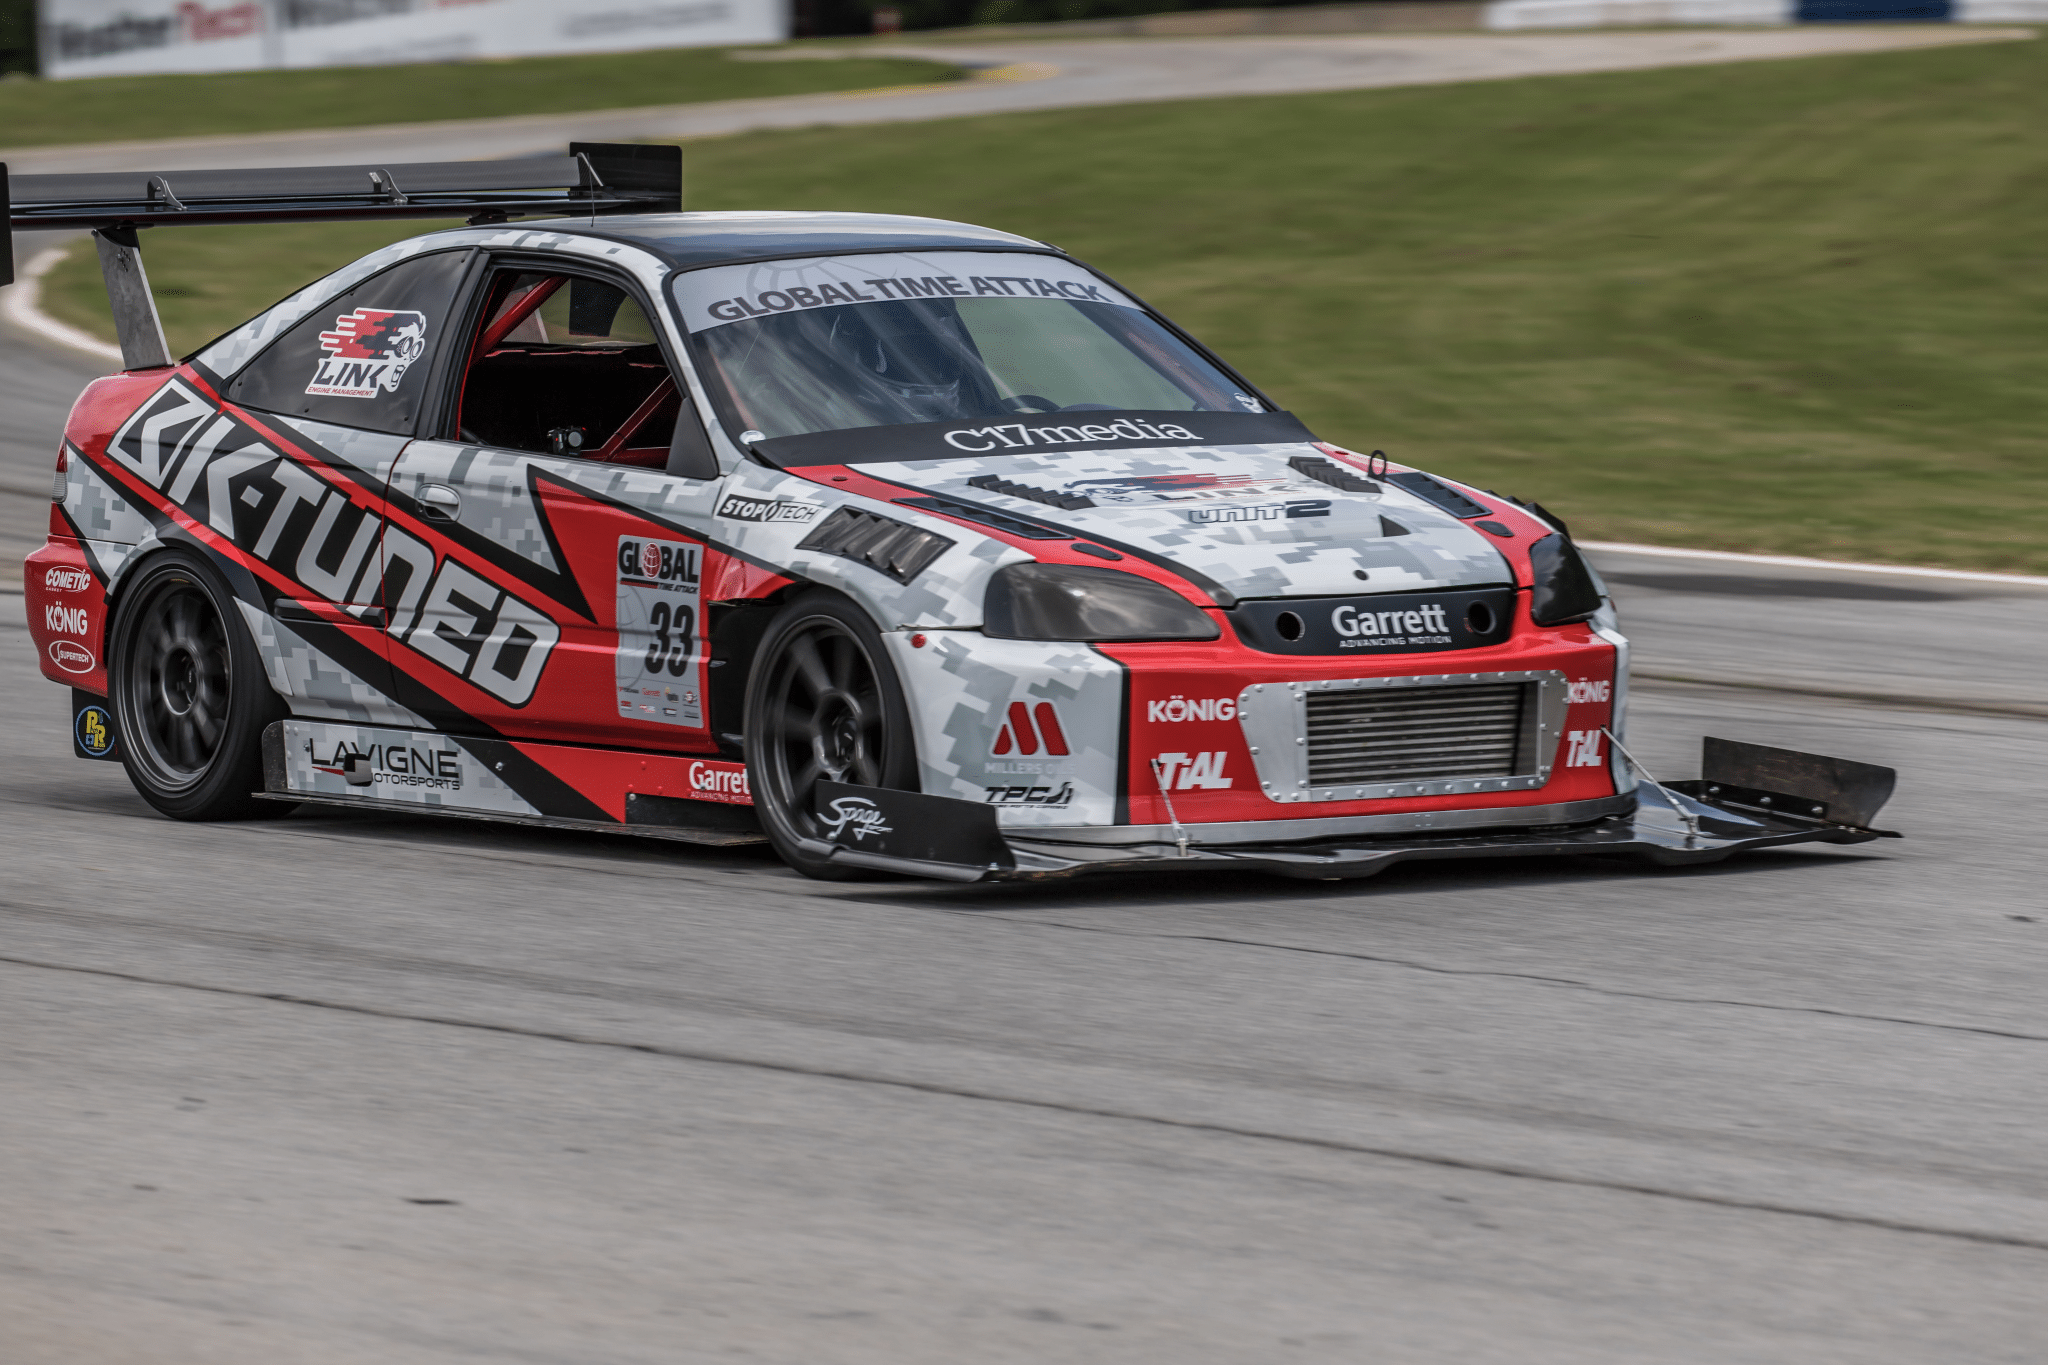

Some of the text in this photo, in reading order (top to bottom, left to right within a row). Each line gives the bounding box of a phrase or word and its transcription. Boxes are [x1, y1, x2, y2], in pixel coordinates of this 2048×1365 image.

[706, 275, 1111, 321] GLOBAL TIME ATTACK
[313, 360, 389, 389] LINK
[307, 387, 375, 397] ENGINE MANAGEMENT
[944, 418, 1204, 451] C17media
[46, 568, 91, 591] COMETIC
[674, 584, 699, 595] ATTACK
[46, 601, 87, 636] KÖNIG
[1331, 604, 1450, 637] Garrett
[645, 601, 694, 677] 33
[1339, 635, 1453, 649] ADVANCING MOTION
[1567, 677, 1611, 703] KÖNIG
[1147, 694, 1237, 722] KÖNIG
[309, 738, 460, 778] LAVIGNE
[371, 772, 461, 791] OTORSPORTS
[688, 761, 750, 795] Garret
